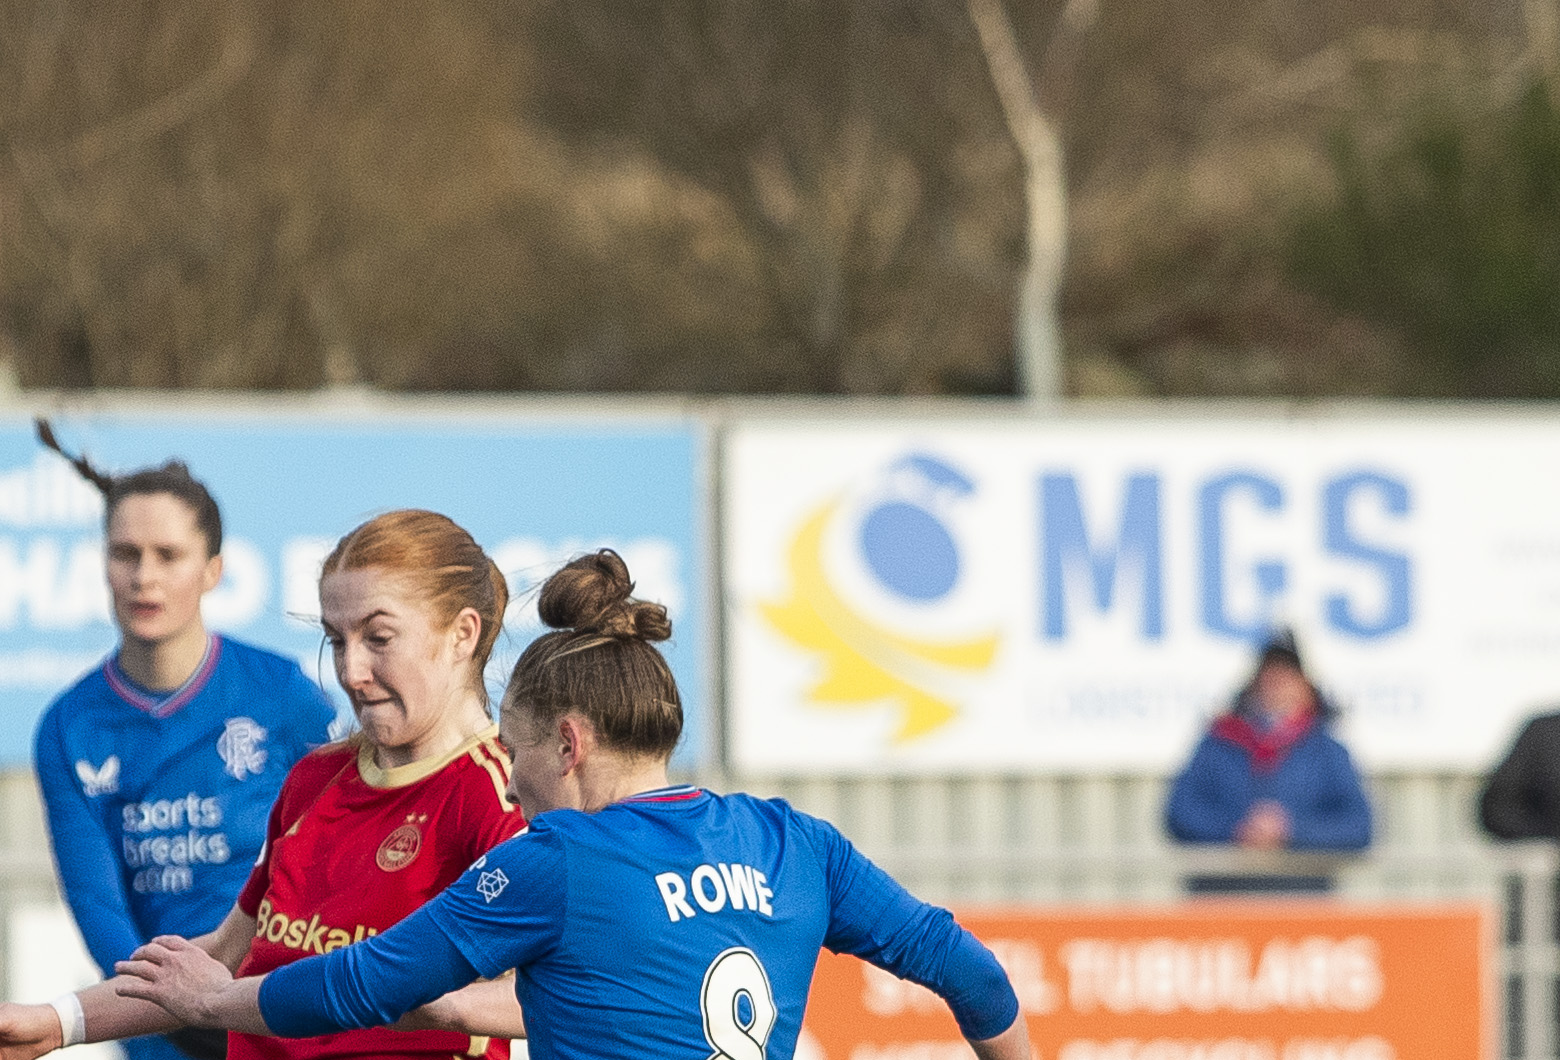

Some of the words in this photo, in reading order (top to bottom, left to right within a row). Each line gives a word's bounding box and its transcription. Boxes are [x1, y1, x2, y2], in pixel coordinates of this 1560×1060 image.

[1035, 466, 1414, 640] MGS
[654, 861, 774, 923] ROWE
[1059, 935, 1385, 1014] TUBULARS
